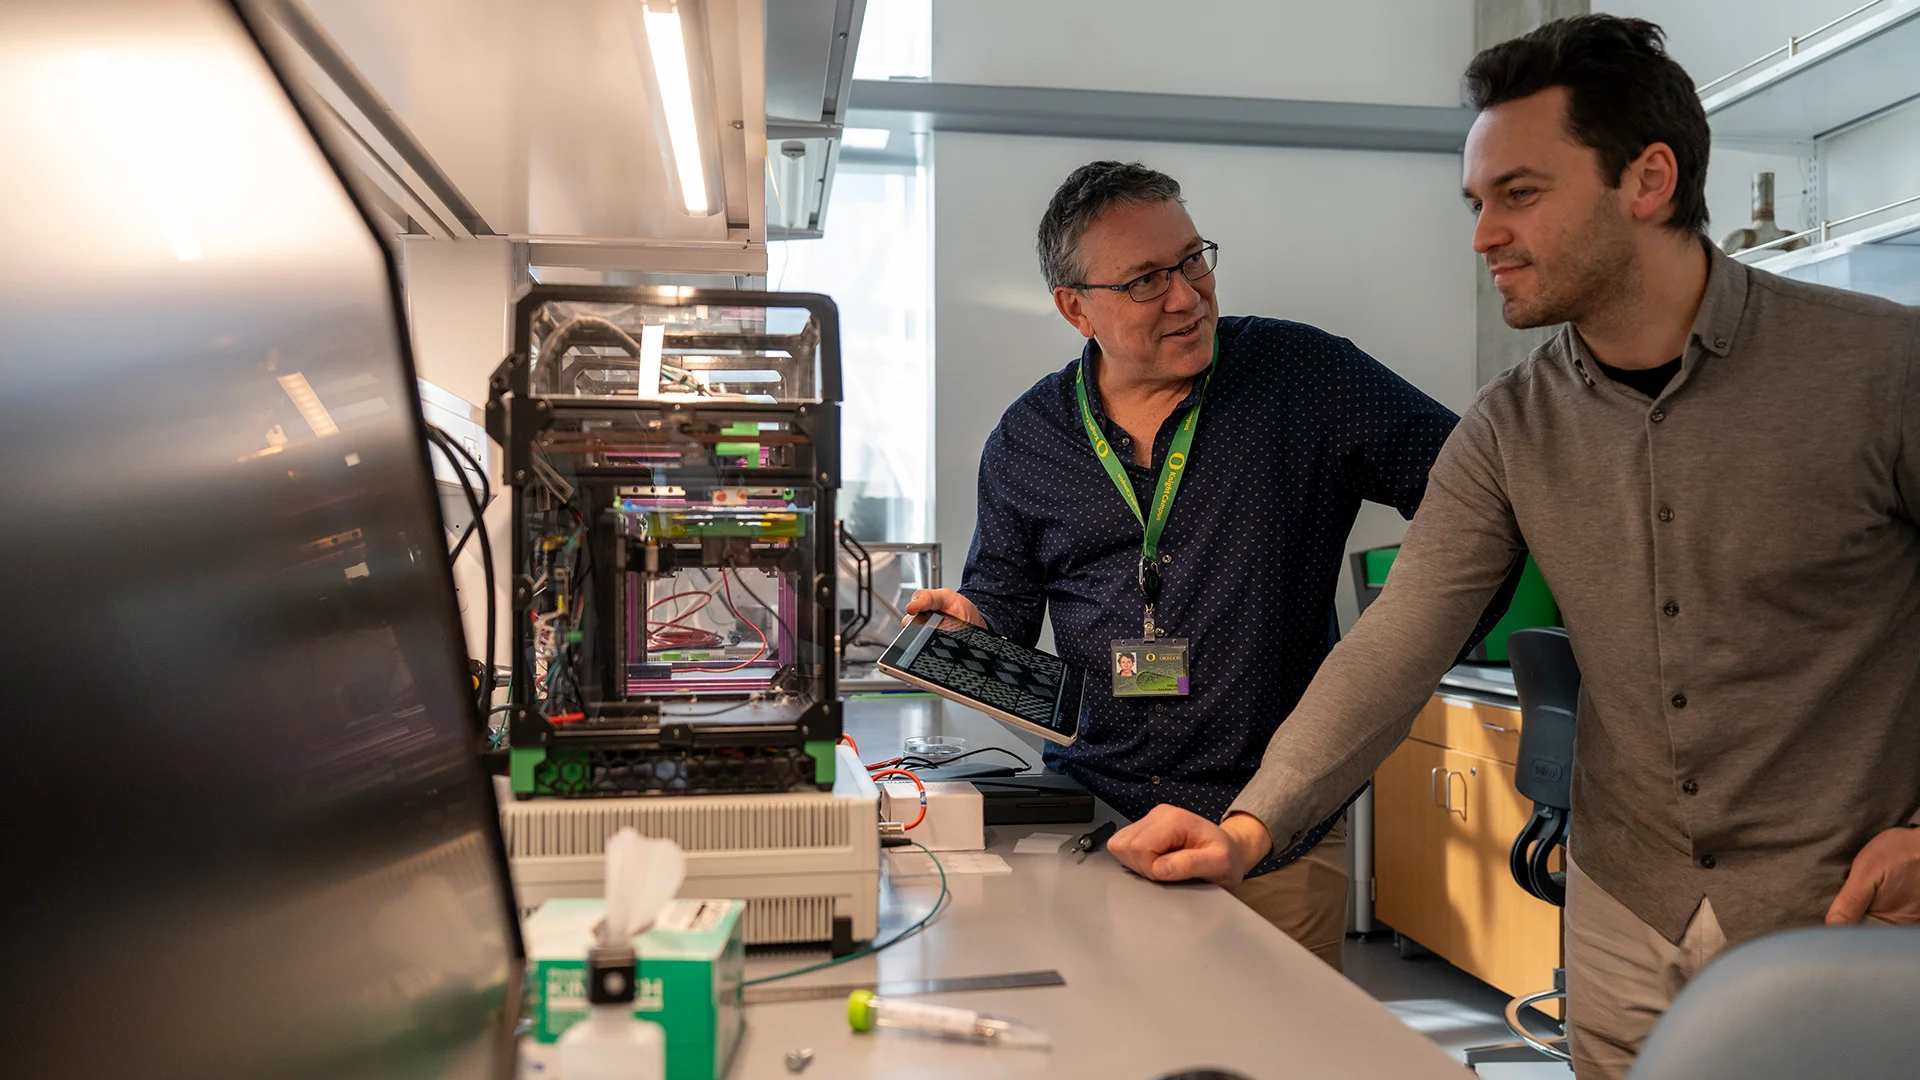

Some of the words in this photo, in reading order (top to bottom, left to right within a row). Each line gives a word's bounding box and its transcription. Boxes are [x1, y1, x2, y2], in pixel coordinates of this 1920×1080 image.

[1083, 399, 1091, 423] Campus
[1087, 421, 1100, 441] Knight
[1096, 440, 1109, 458] O
[1169, 452, 1185, 470] O
[1117, 473, 1132, 498] Campus
[1164, 471, 1177, 494] Knight
[1156, 494, 1169, 521] Campus
